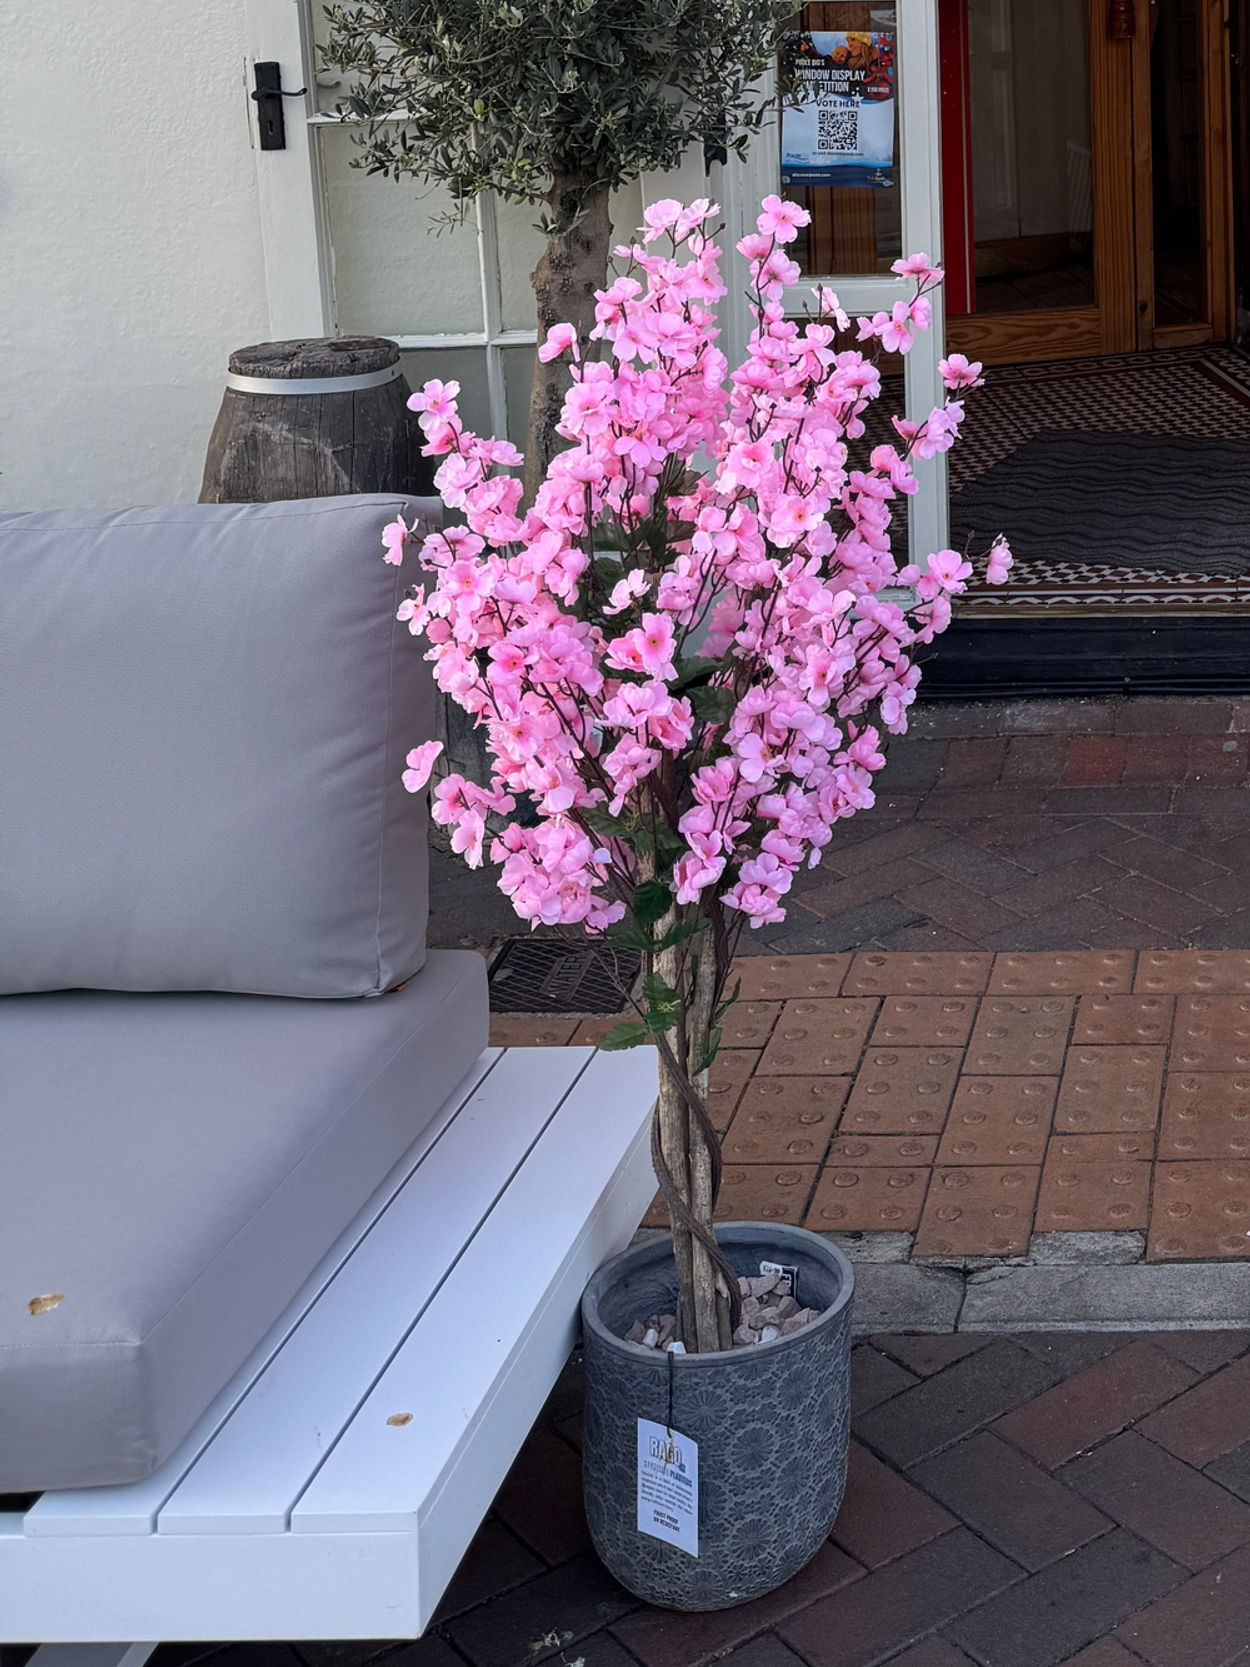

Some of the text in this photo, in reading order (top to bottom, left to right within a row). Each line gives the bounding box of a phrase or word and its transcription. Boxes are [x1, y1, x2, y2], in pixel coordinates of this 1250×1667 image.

[794, 69, 865, 81] WINDOW DISPLAY
[816, 100, 860, 108] VOTE HERE
[649, 1435, 682, 1465] RAGO
